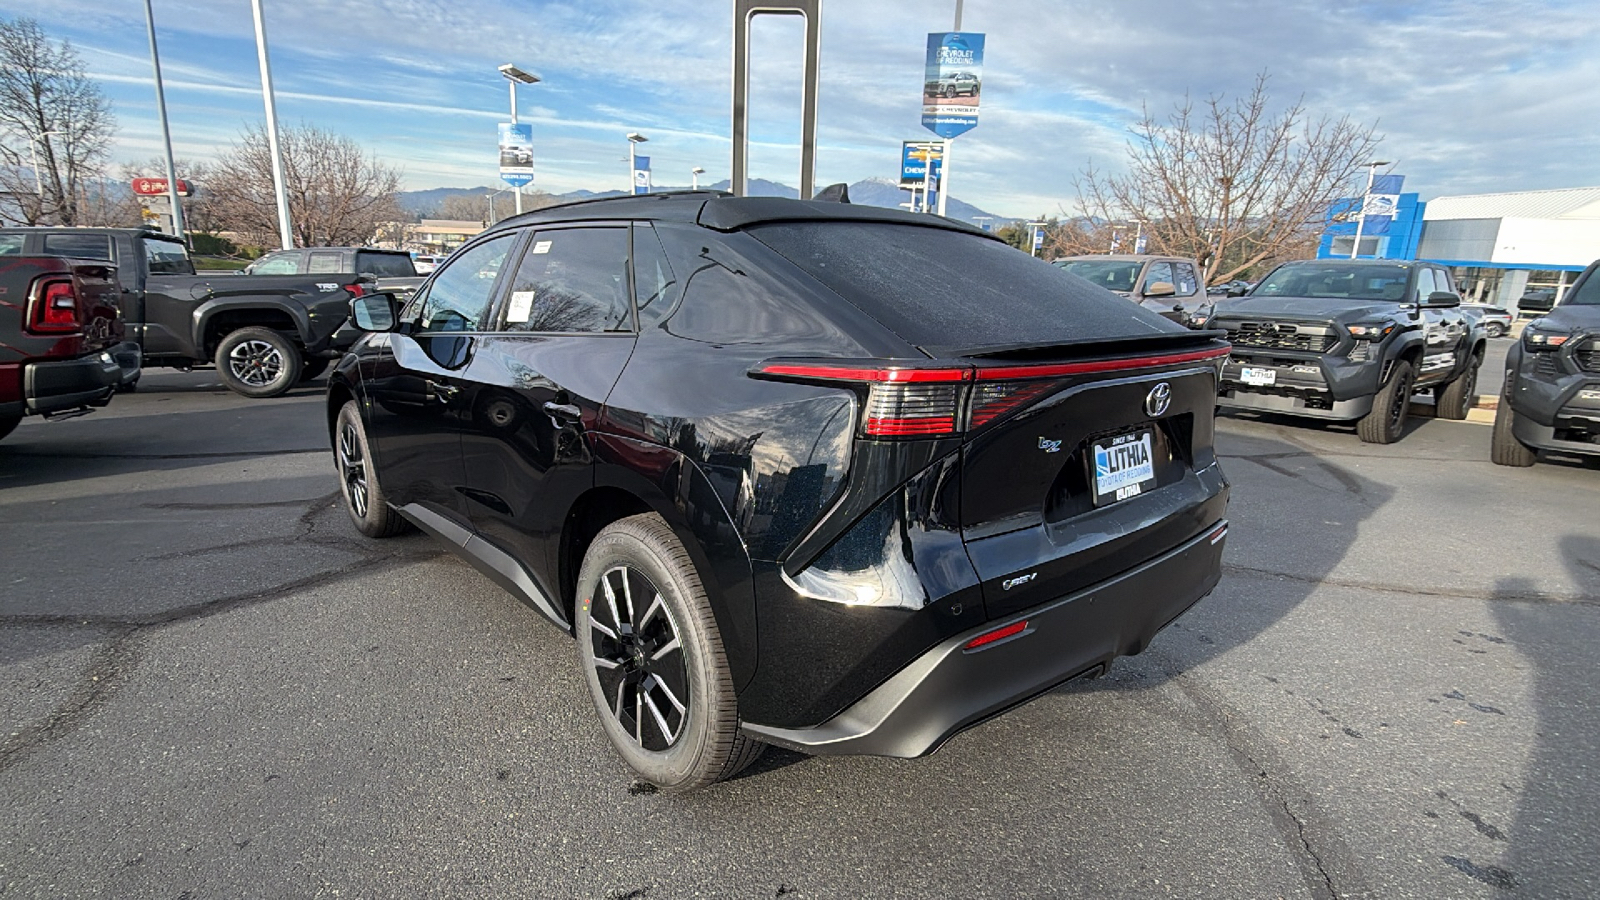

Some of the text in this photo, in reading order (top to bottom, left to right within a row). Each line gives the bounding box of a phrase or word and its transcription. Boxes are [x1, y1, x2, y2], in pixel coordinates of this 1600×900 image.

[936, 50, 974, 58] CHEVROLET
[1250, 370, 1274, 379] LITHIA
[1112, 436, 1126, 445] SINCE
[1107, 442, 1149, 473] LITHIA
[1097, 465, 1151, 488] TOYOTA OF REDDING
